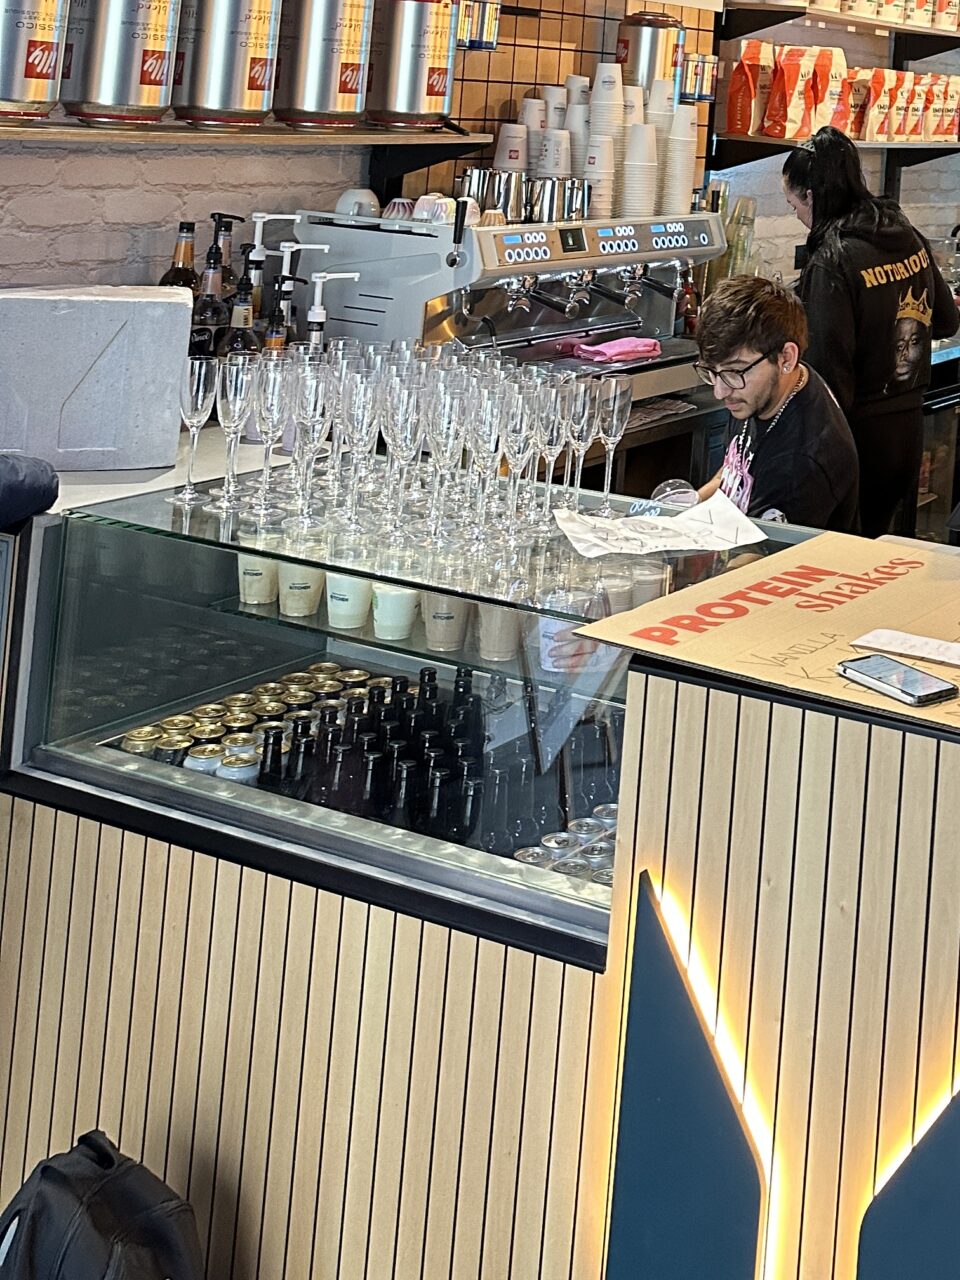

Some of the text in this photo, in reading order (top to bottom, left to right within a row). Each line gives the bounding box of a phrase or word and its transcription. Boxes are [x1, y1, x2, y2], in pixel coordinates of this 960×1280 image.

[28, 44, 57, 74] illy
[143, 53, 169, 80] illy
[794, 557, 925, 613] shakes
[629, 564, 842, 646] PROTEIN
[736, 632, 845, 668] VANILLA
